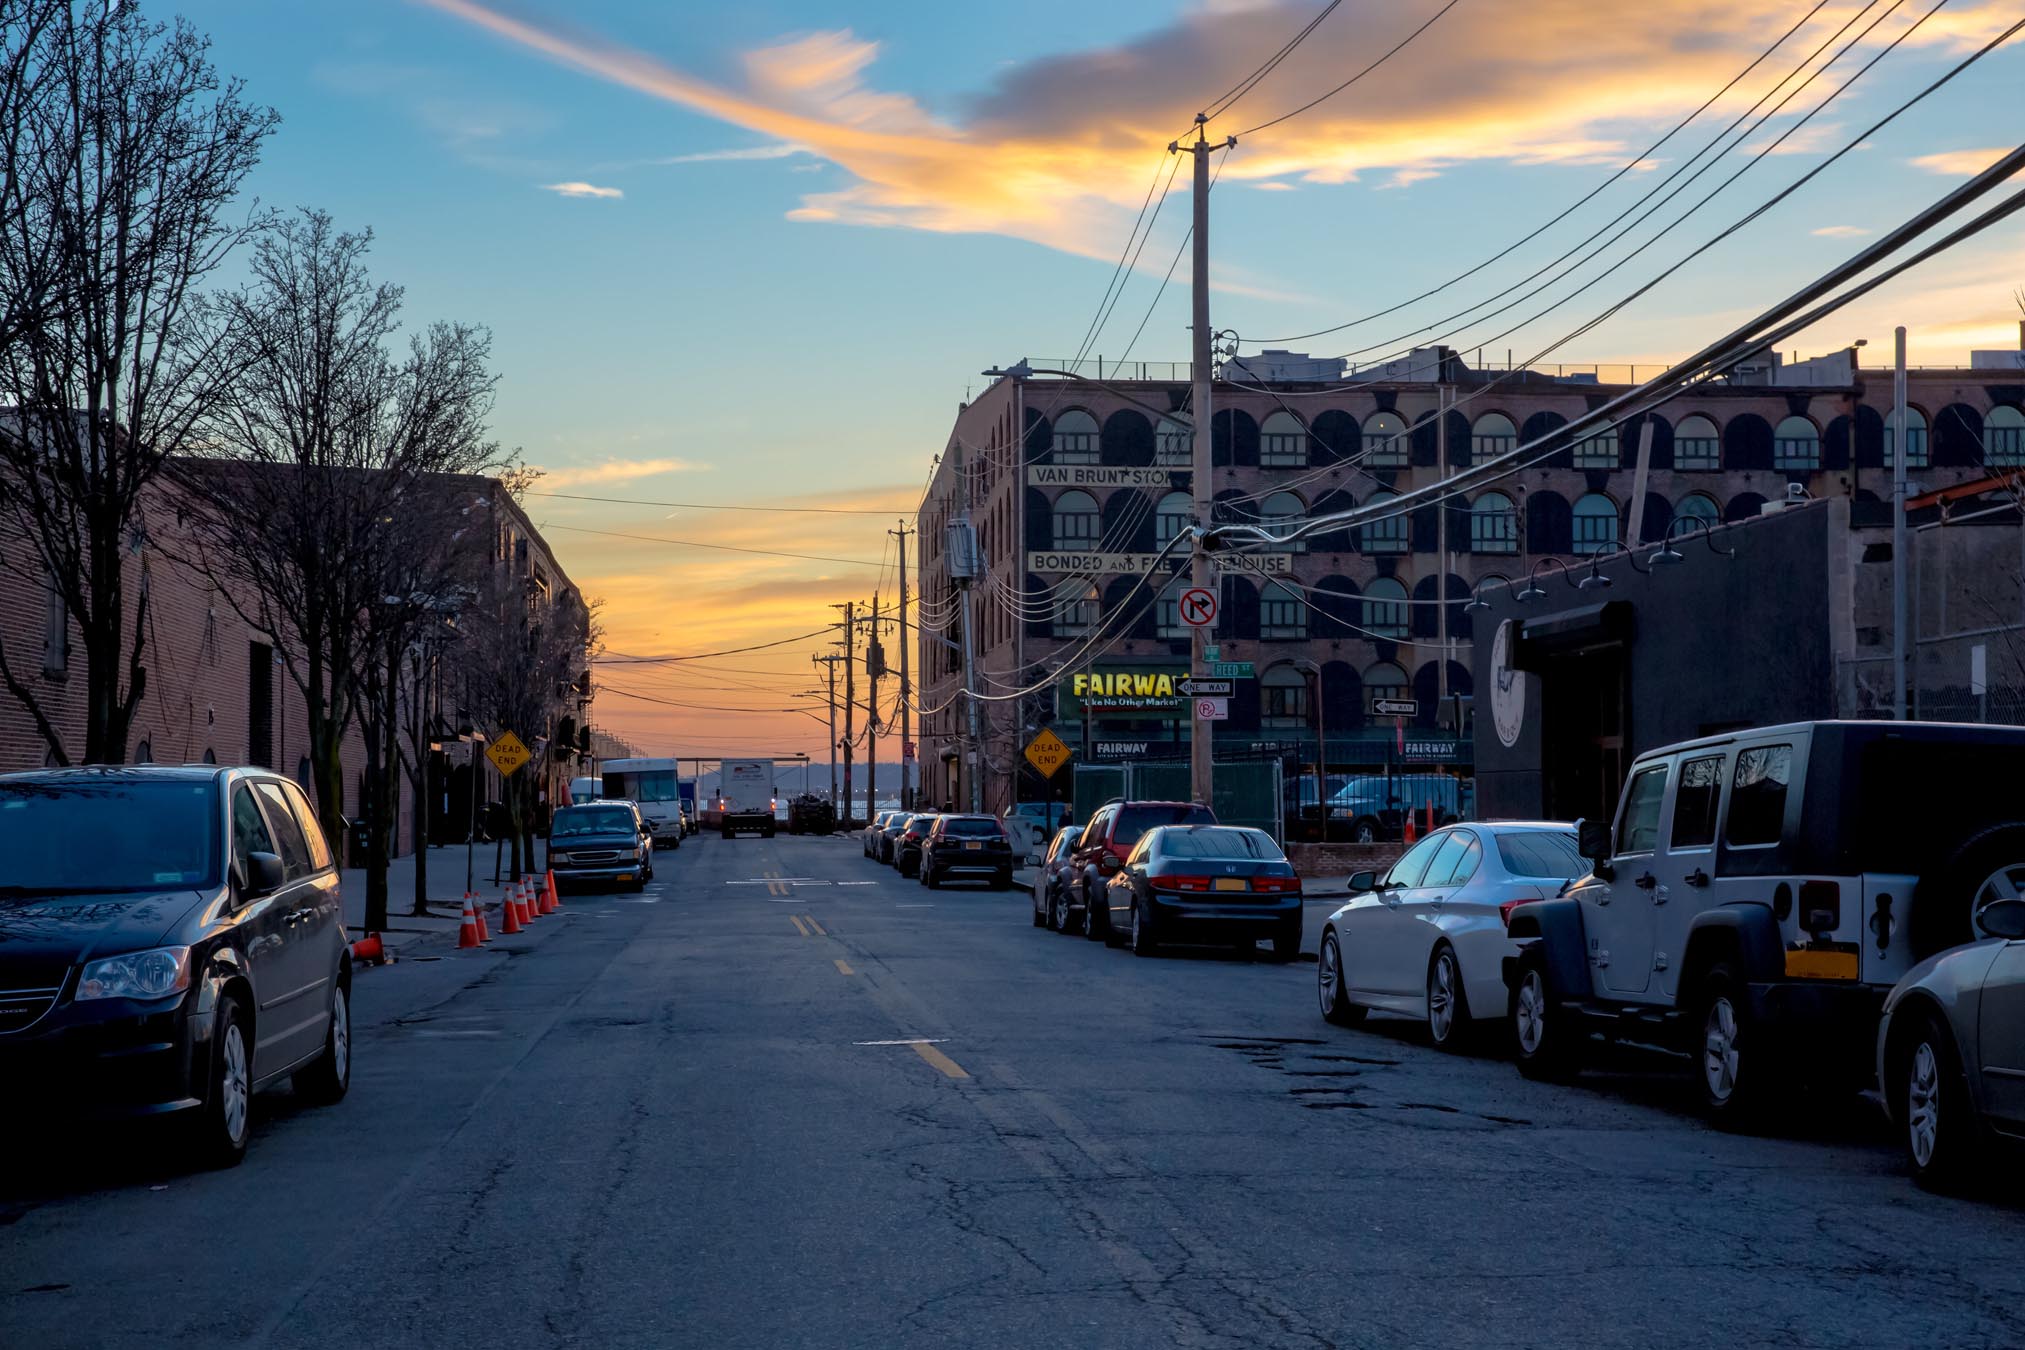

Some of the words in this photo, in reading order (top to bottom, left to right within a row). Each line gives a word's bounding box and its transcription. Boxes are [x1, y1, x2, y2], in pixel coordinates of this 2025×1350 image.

[1036, 468, 1068, 482] VAN
[1075, 469, 1126, 483] BRUNT
[1036, 555, 1102, 570] BONDED
[1110, 561, 1135, 571] AND
[1216, 664, 1239, 676] REED
[1073, 673, 1191, 697] FAIRWA
[1183, 683, 1201, 692] ONE
[1208, 683, 1227, 692] WAY
[1104, 698, 1116, 707] No
[495, 744, 521, 753] DEAD
[1034, 743, 1061, 753] DEAD
[1096, 742, 1149, 754] FAIRWAY
[1404, 742, 1456, 754] FAIRWAY
[498, 756, 517, 765] END
[1038, 755, 1057, 765] END
